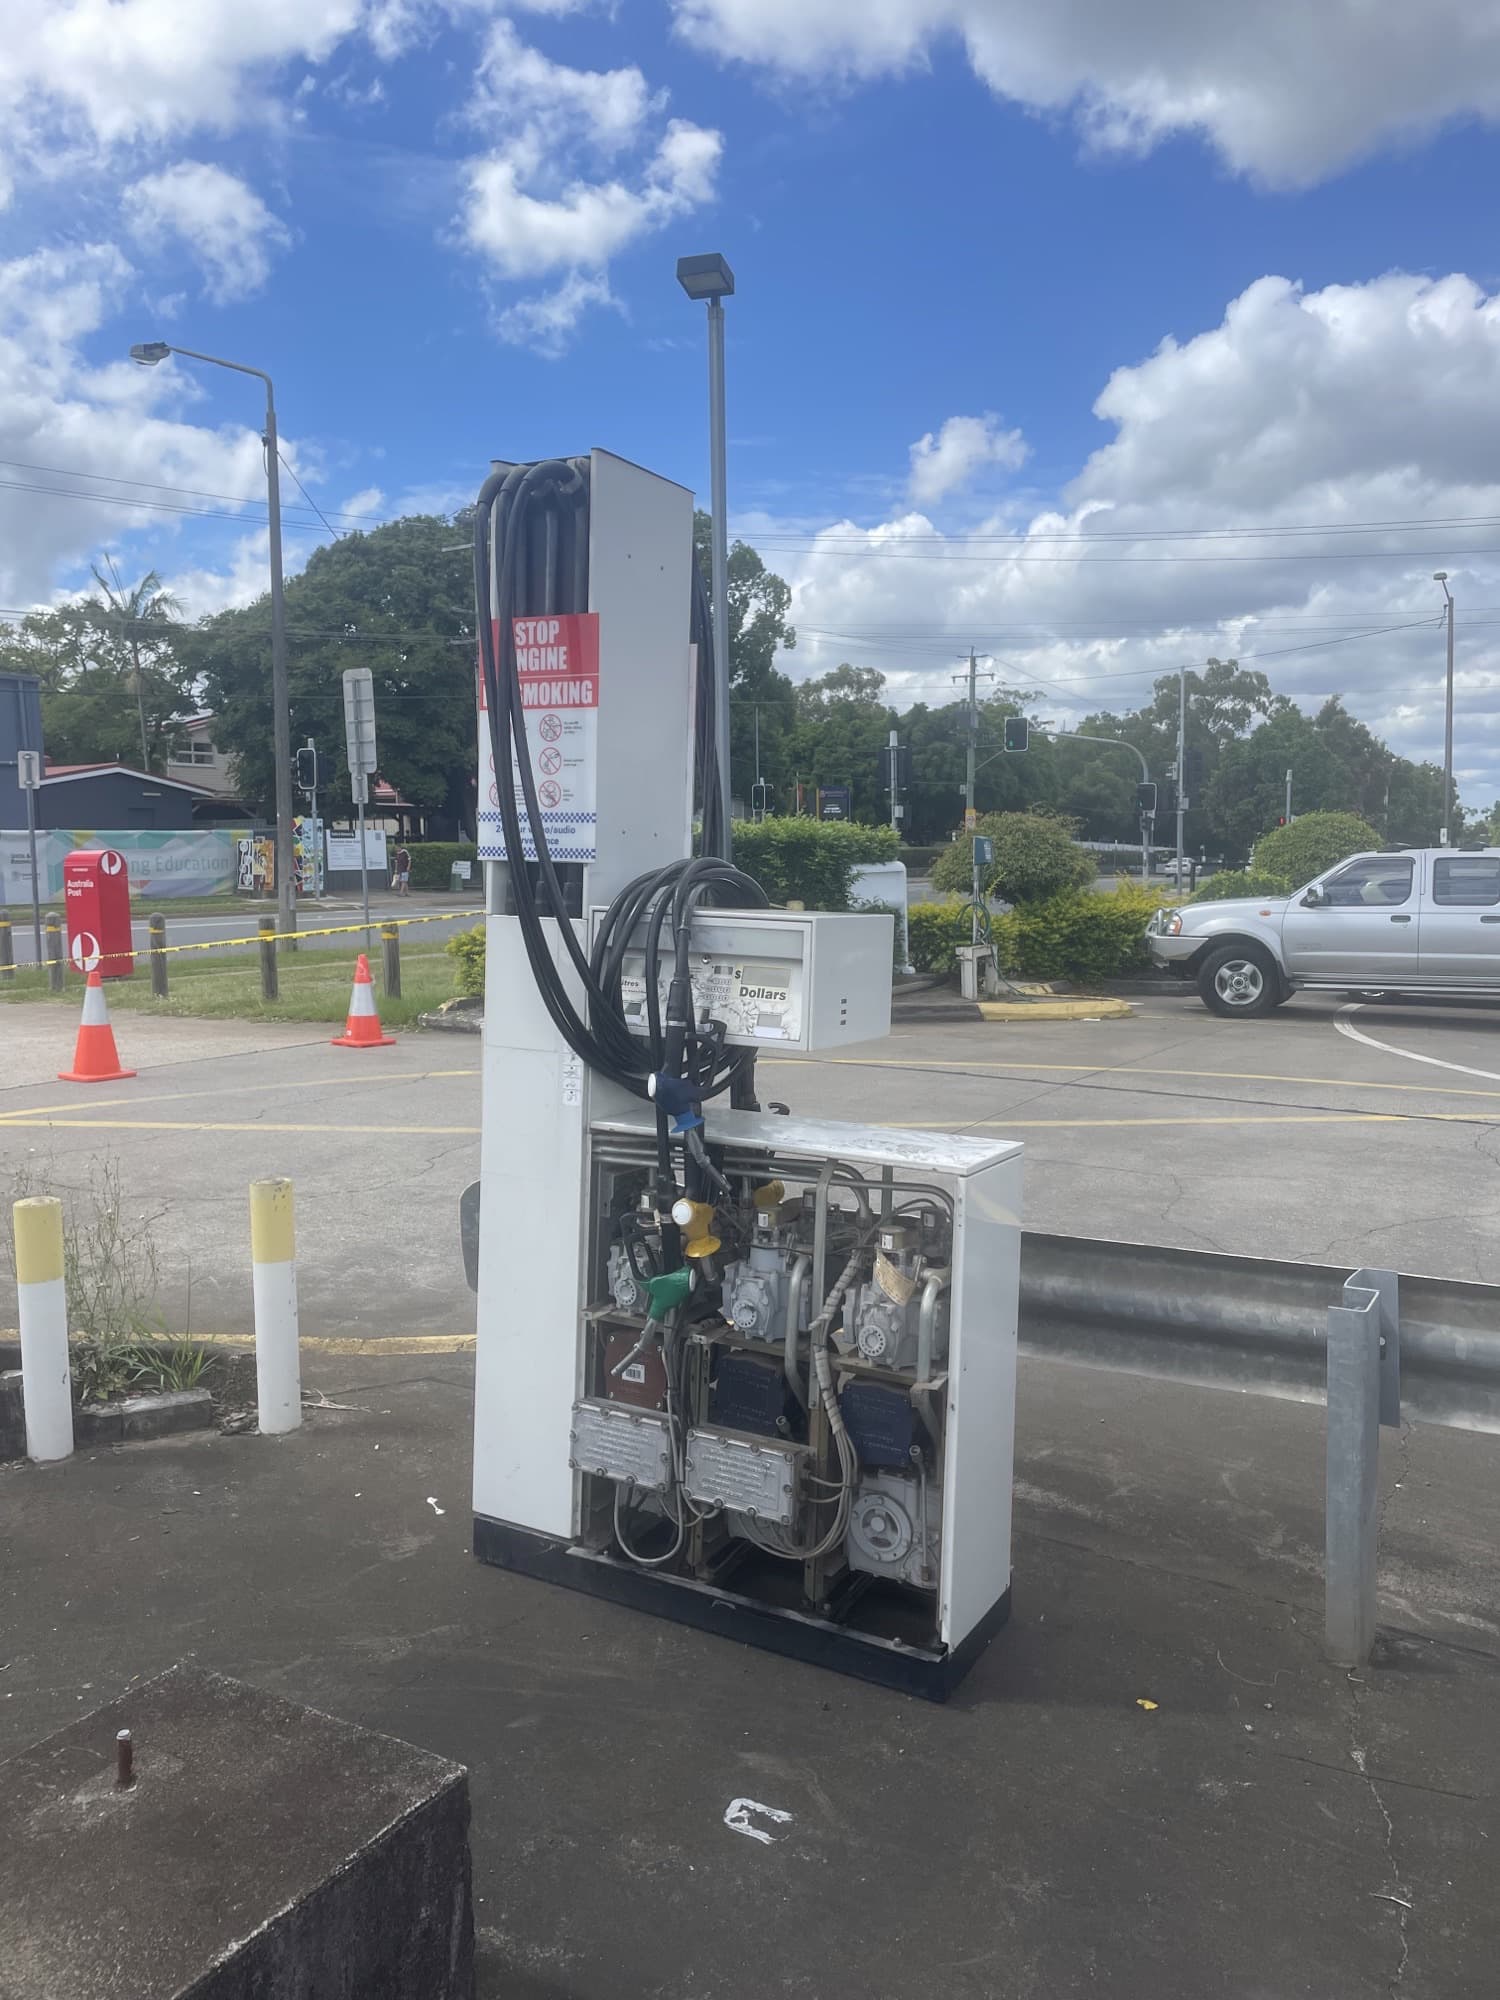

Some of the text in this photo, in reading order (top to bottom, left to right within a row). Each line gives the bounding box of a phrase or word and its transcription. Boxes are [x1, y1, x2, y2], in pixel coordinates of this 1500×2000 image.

[515, 620, 560, 646] STOP
[516, 646, 568, 672] NGINE
[155, 855, 229, 872] Education
[67, 879, 94, 888] Australia
[67, 888, 82, 897] Post
[739, 986, 787, 1001] Dollars
